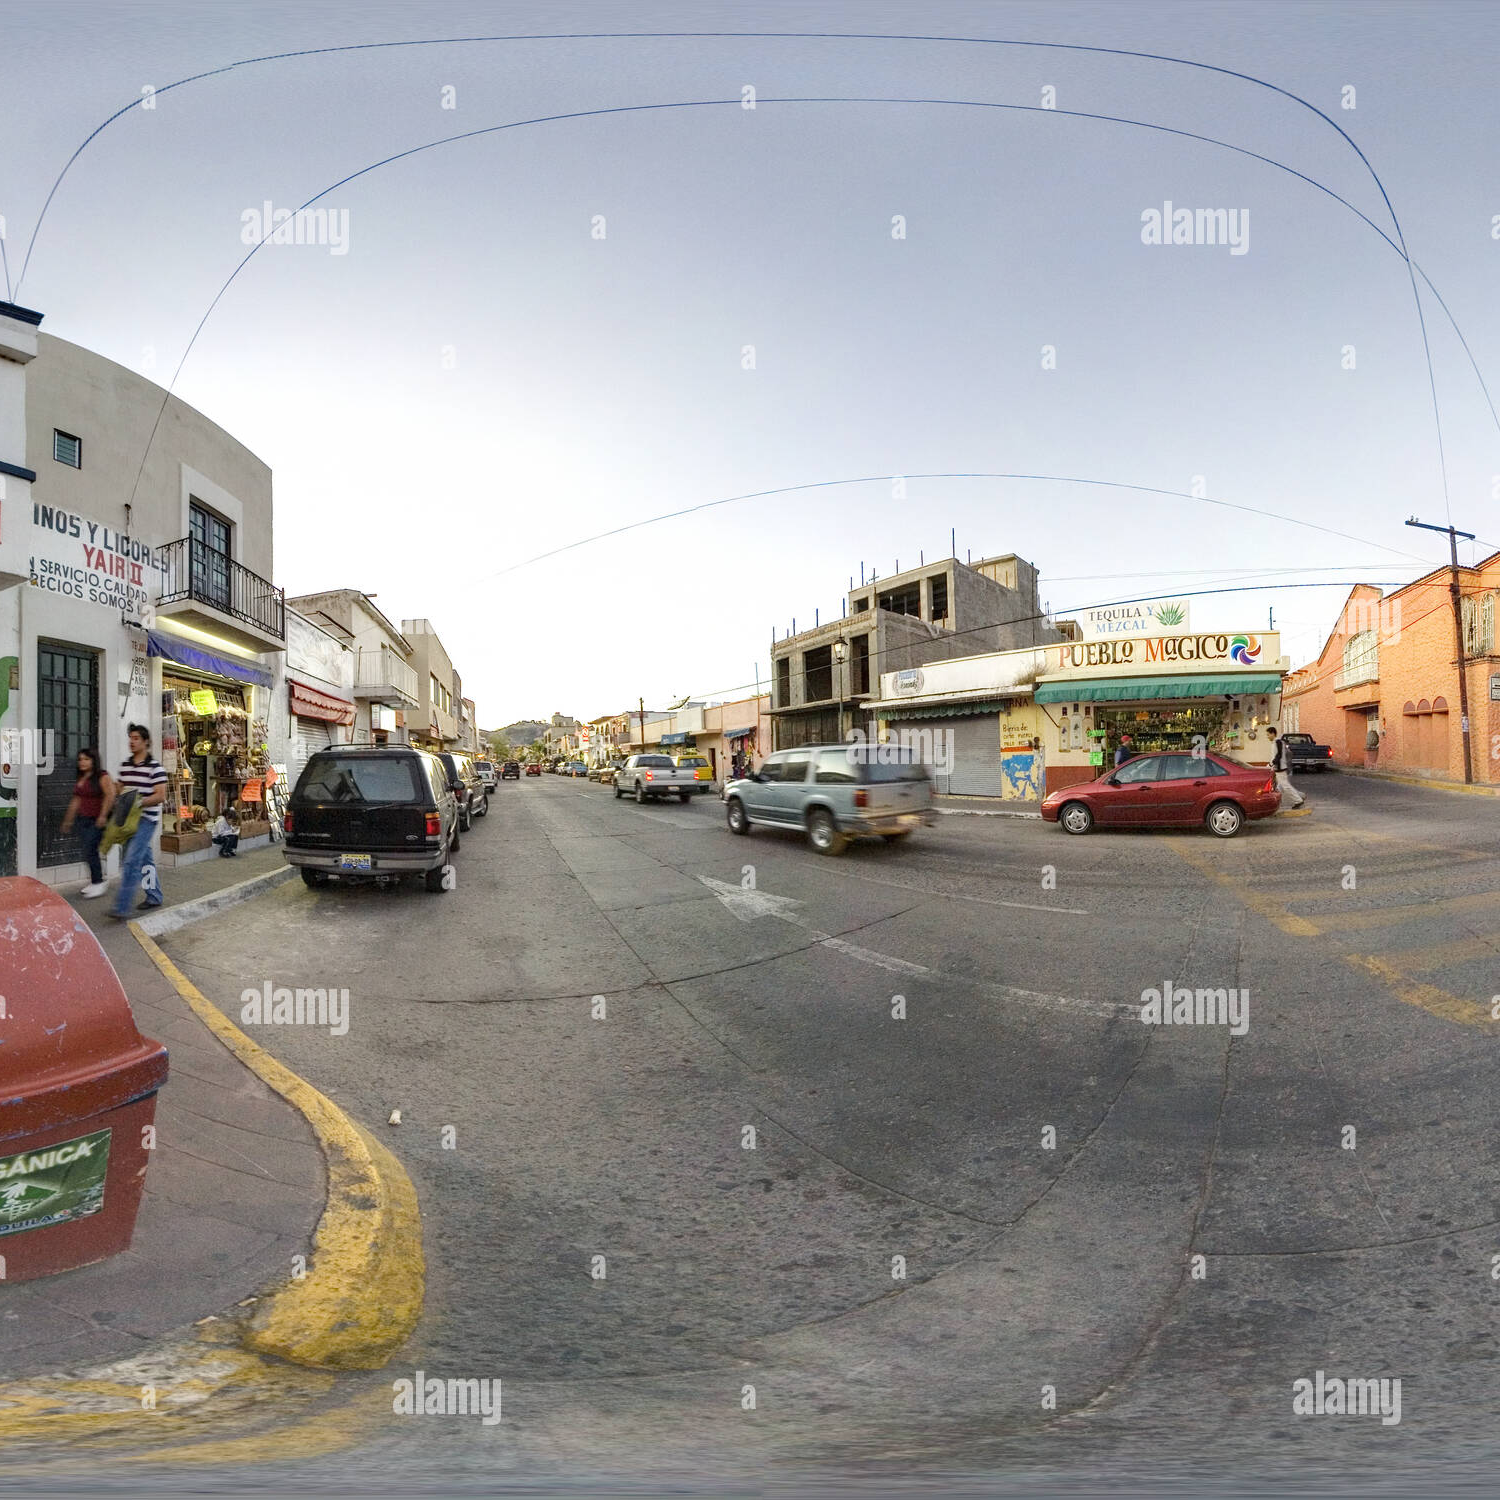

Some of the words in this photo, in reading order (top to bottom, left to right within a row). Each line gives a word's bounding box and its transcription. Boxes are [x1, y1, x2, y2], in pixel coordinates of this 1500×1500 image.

[33, 502, 81, 538] INOS
[87, 520, 99, 544] Y
[103, 527, 171, 574] LICORES
[82, 543, 125, 580] YAIR
[129, 562, 143, 587] II
[30, 572, 83, 599] RECIOS
[89, 588, 134, 614] SOMOS
[1089, 607, 1142, 622] TEQUILA
[1146, 605, 1155, 616] Y
[1095, 619, 1148, 634] MEZCAL
